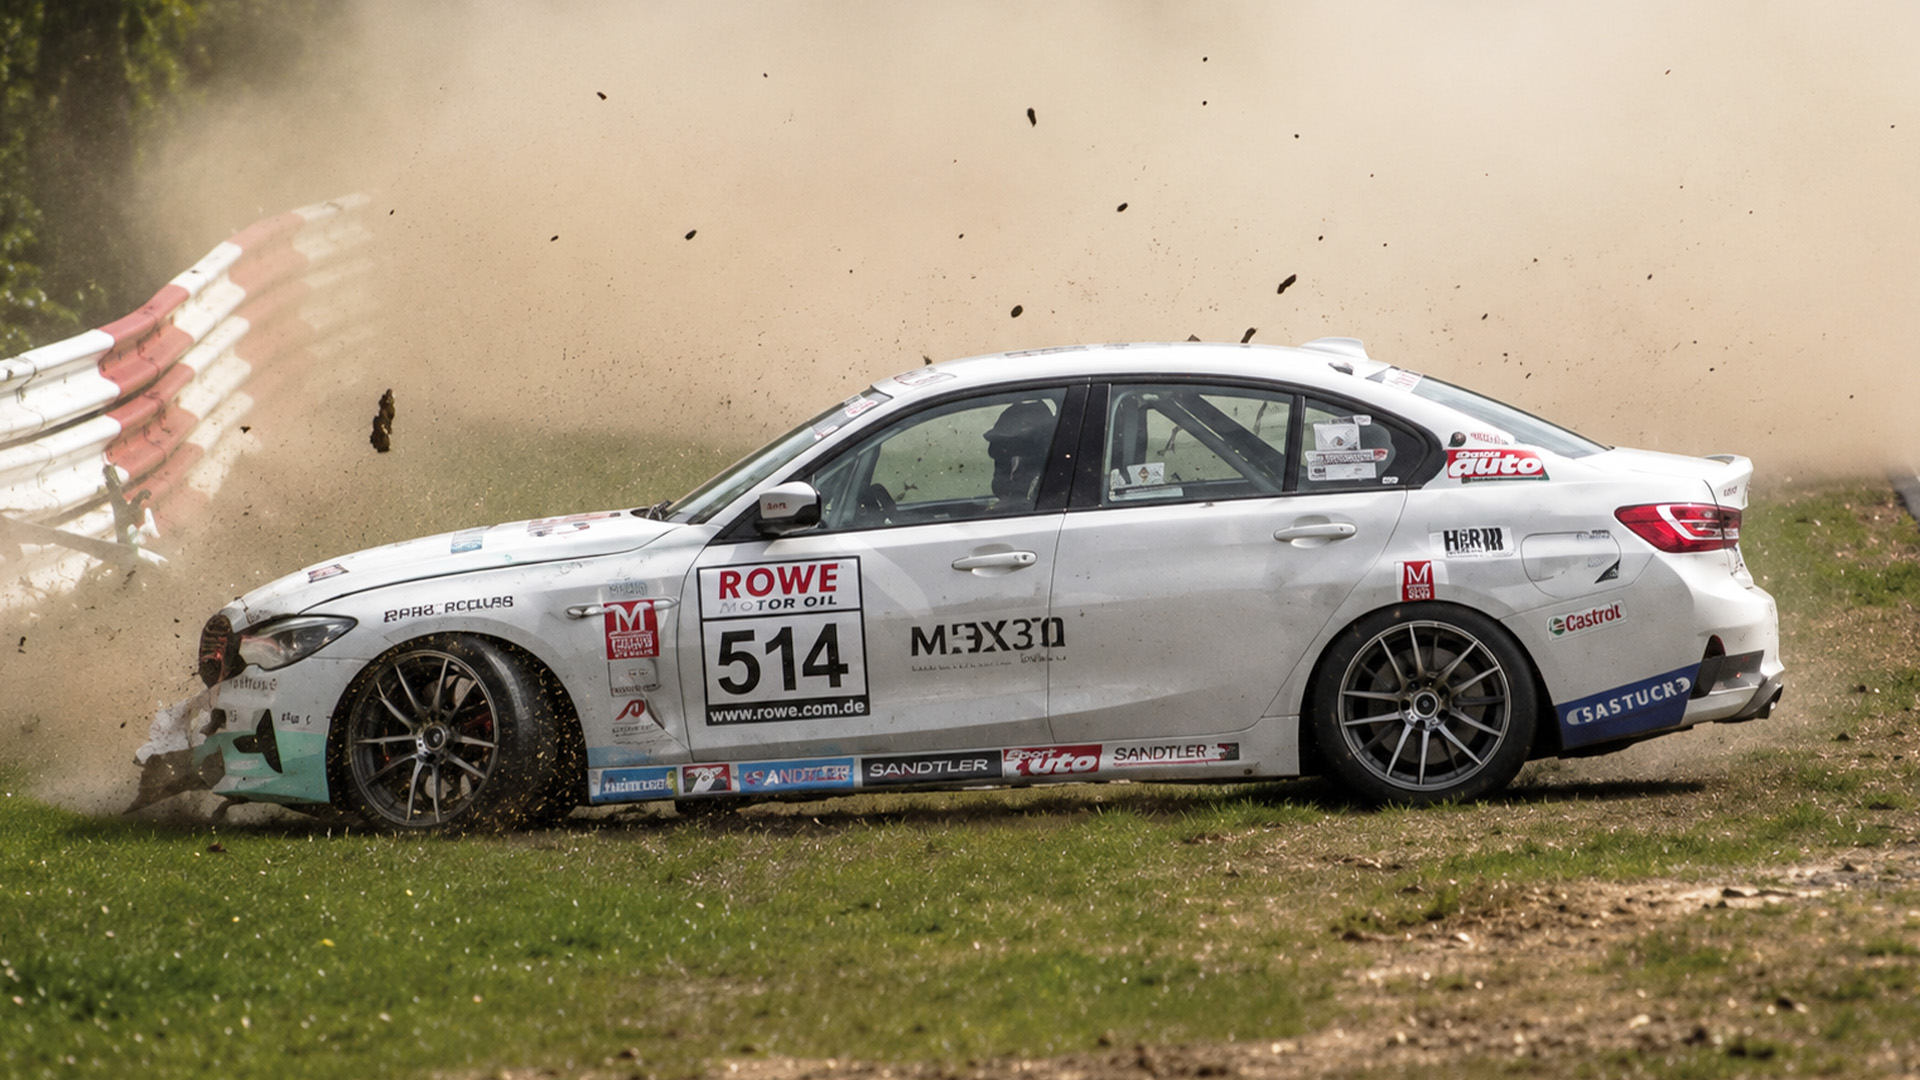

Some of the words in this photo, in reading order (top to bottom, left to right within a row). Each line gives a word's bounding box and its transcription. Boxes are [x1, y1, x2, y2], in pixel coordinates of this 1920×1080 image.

[1449, 454, 1542, 477] auto
[719, 563, 839, 600] ROWE
[719, 598, 795, 614] MOTOR
[804, 595, 837, 606] OIL
[1565, 604, 1621, 632] Castrol
[718, 623, 849, 695] 514
[709, 699, 865, 723] www.rowe.com.de
[1113, 744, 1207, 761] SANDTLER
[869, 759, 988, 777] SANDTLER
